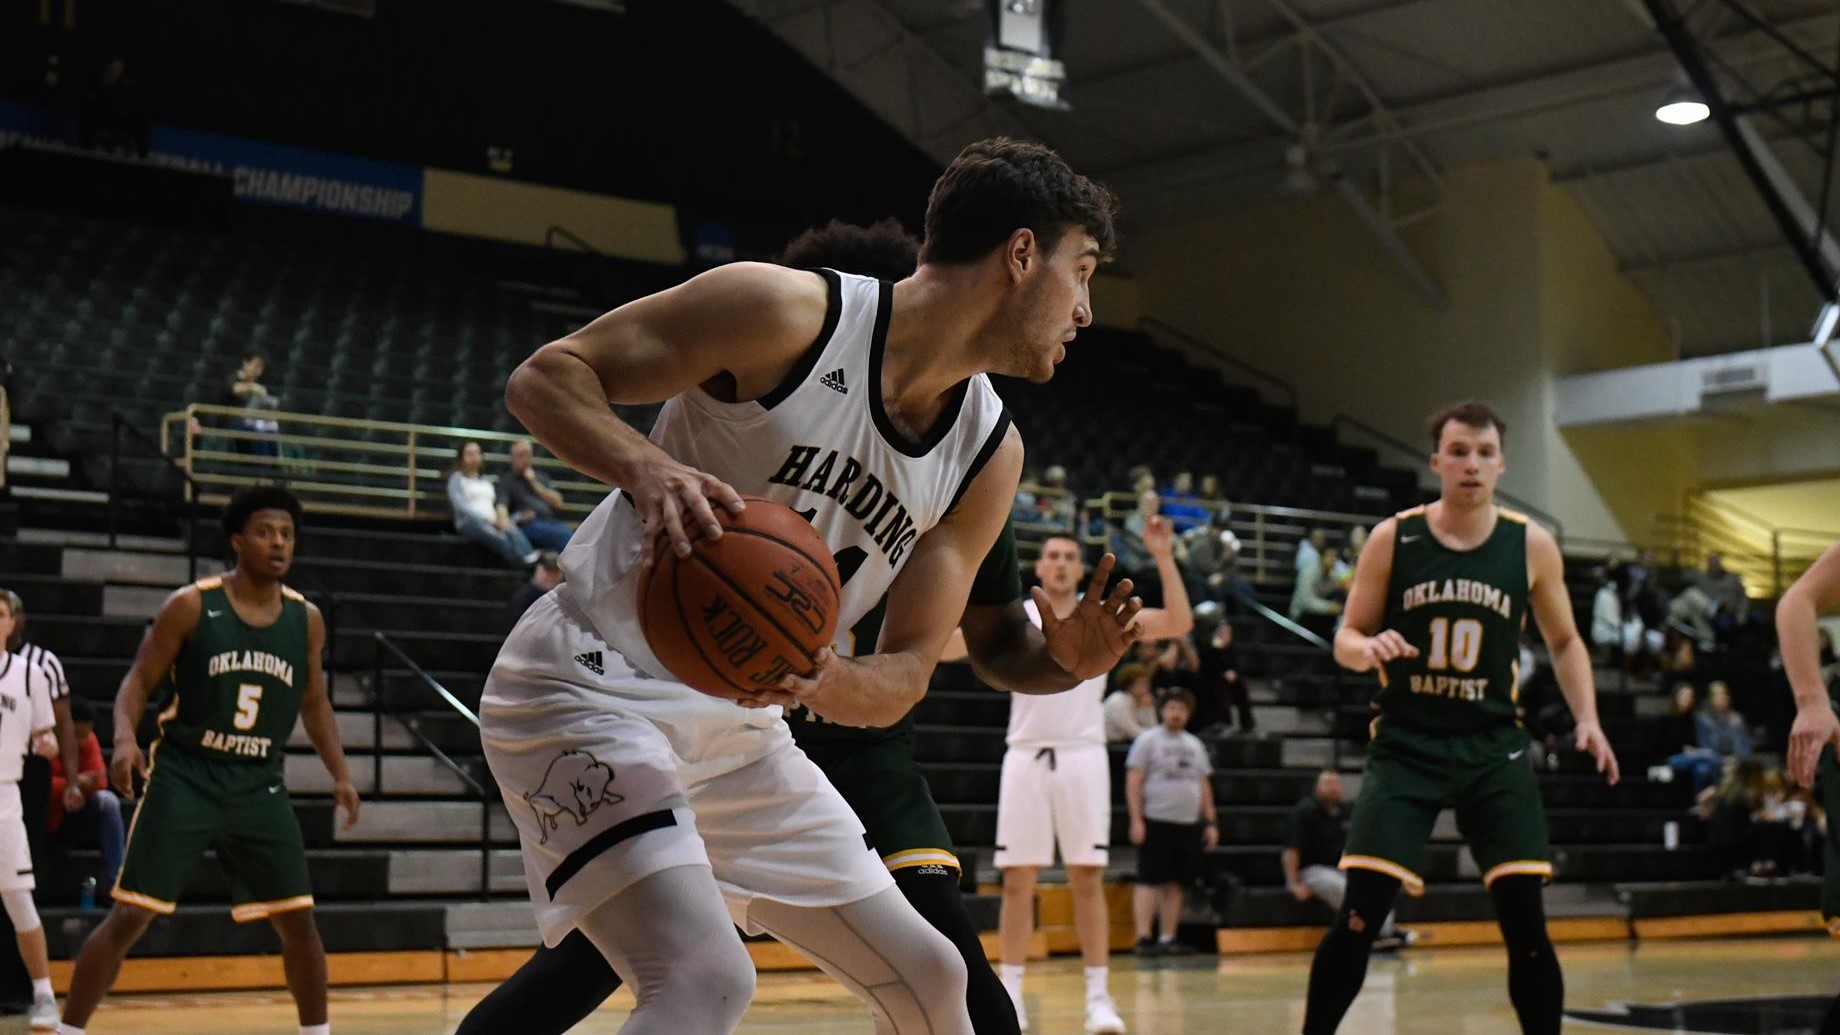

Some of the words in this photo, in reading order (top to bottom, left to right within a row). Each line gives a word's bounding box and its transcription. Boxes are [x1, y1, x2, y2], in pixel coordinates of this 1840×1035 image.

[232, 165, 414, 220] CHAMPIONSHIP
[820, 377, 848, 394] adidas
[768, 445, 916, 569] HARDING
[1402, 578, 1512, 620] OKLAHOMA
[1426, 617, 1484, 672] 10
[208, 649, 294, 688] OKLAHOMA
[574, 655, 604, 676] adidas
[232, 682, 264, 731] 5
[1408, 673, 1489, 702] BAPTIST
[200, 729, 273, 759] BAPTIST
[917, 865, 949, 876] adidas
